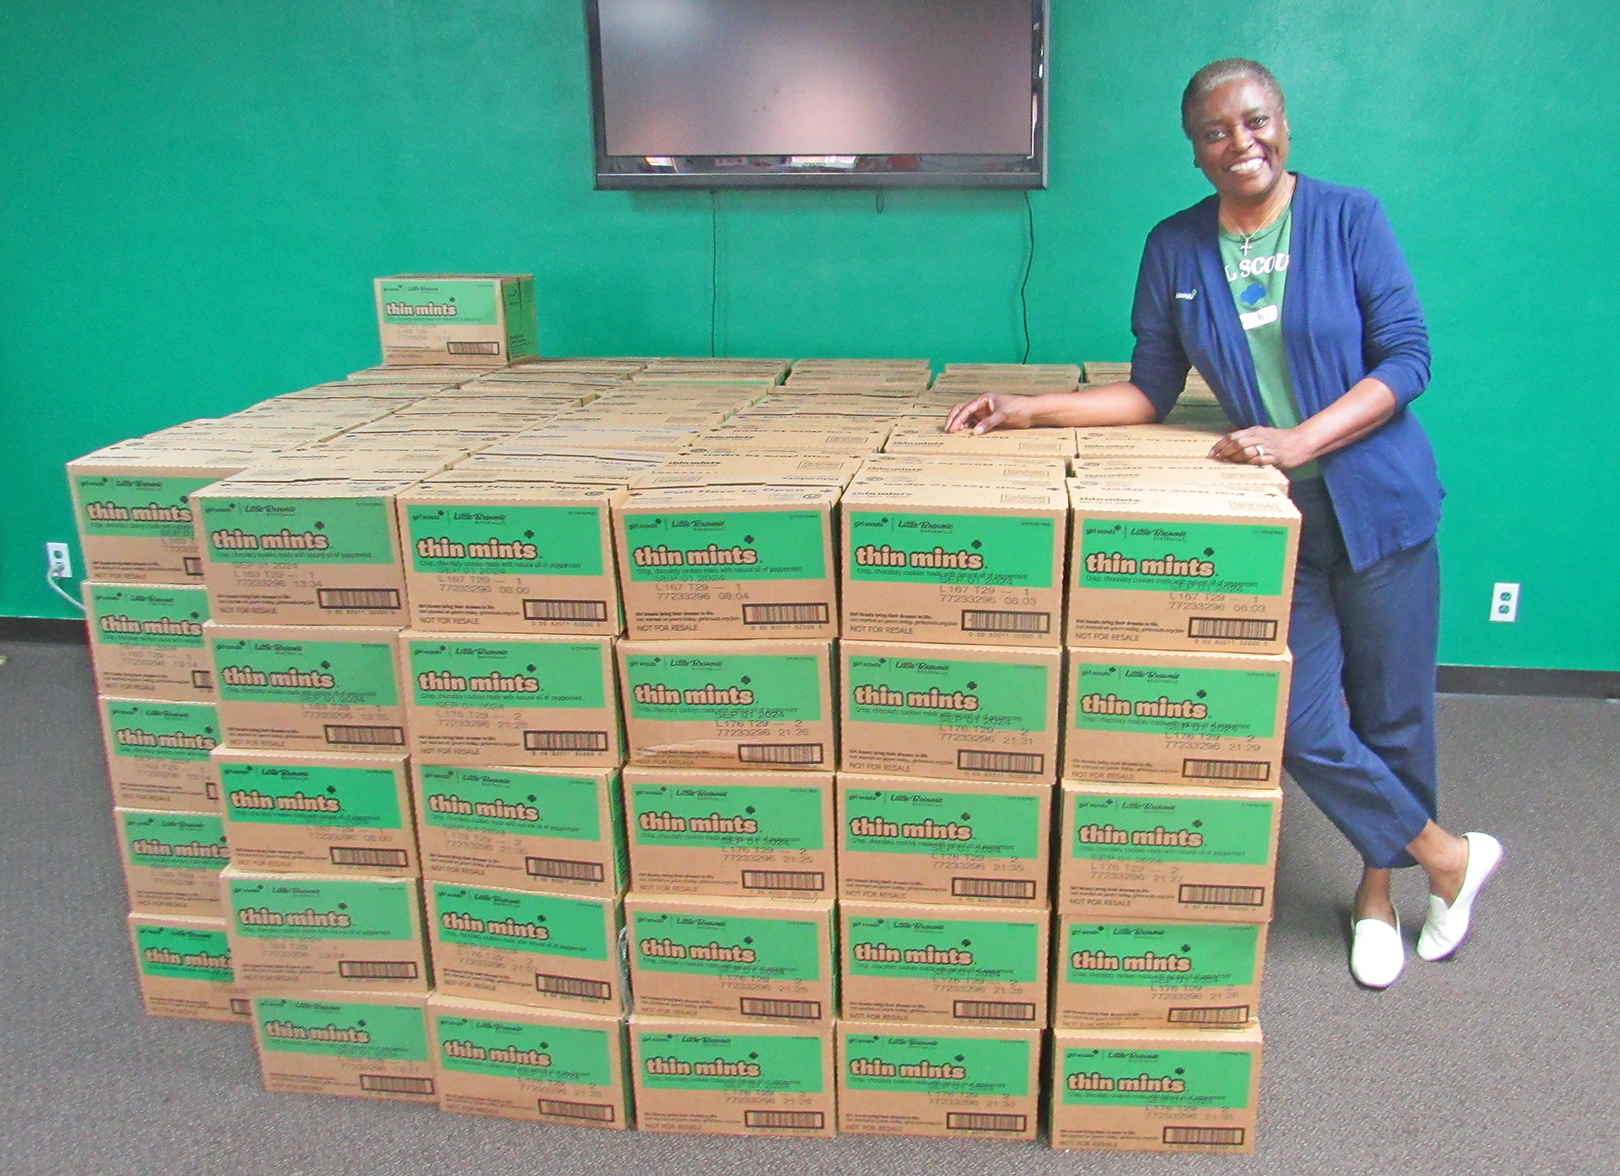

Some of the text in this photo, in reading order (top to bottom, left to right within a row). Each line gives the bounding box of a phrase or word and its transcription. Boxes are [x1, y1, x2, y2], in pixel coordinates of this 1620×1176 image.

[384, 301, 456, 315] thin mints
[85, 501, 192, 522] thin mints
[210, 528, 328, 549] thin mints
[416, 536, 537, 559] thin mints
[633, 543, 757, 566] thin mints
[854, 544, 983, 569] thin mints
[1084, 551, 1215, 576] thin mints
[439, 584, 491, 592] 77233296
[940, 594, 995, 603] 77233296
[1168, 602, 1225, 610] 77233296
[99, 614, 202, 636] thin mints
[221, 665, 334, 687] thin mints
[417, 670, 538, 692] thin mints
[632, 683, 753, 704] thin mints
[853, 683, 978, 709] thin mints
[1080, 692, 1208, 718] thin mints
[115, 727, 156, 746] thin
[158, 730, 216, 749] mints
[716, 728, 770, 736] 77233296
[228, 789, 340, 811] thin mints
[428, 793, 539, 820] thin mints
[638, 810, 757, 833] thin mints
[849, 815, 972, 839] thin mints
[1078, 823, 1203, 846] thin mints
[131, 838, 172, 855] thin
[237, 907, 350, 927] thin mints
[441, 911, 548, 938] thin mints
[143, 946, 182, 964] thin
[639, 937, 755, 961] thin mints
[853, 942, 972, 964] thin mints
[1070, 950, 1191, 971] thin mints
[265, 1020, 371, 1043] thin mints
[442, 1039, 551, 1065] thin mints
[644, 1056, 760, 1076] thin mints
[849, 1057, 965, 1078] thin mints
[1066, 1071, 1185, 1092] thin mints
